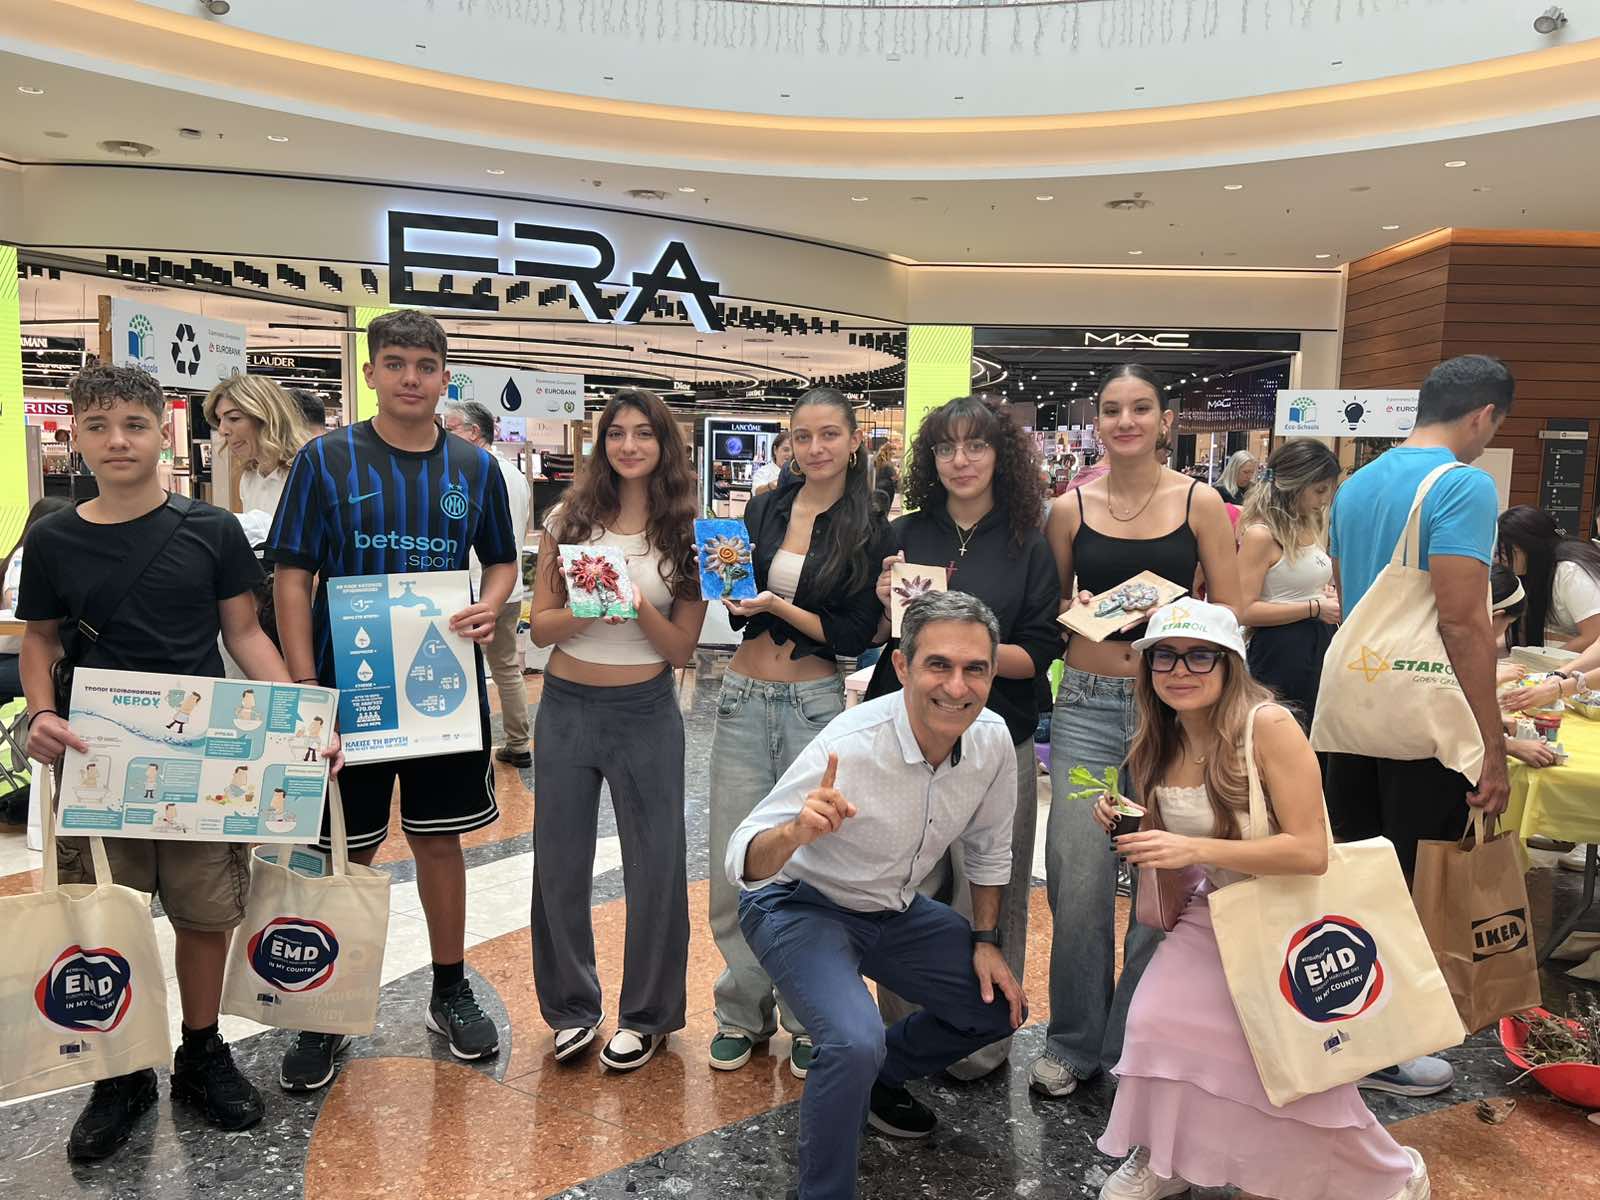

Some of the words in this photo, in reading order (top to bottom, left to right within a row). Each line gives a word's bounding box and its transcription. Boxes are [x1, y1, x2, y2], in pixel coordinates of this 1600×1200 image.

[388, 211, 726, 332] ERA
[254, 355, 295, 367] LAUDER
[545, 388, 577, 396] EUROBANK
[673, 381, 691, 391] Dior
[24, 403, 68, 414] RINS
[354, 530, 458, 553] betsson
[1161, 622, 1208, 633] STAROIL
[112, 695, 161, 707] ΝΕΡΟΥ
[1474, 921, 1520, 948] IKEA
[271, 939, 319, 961] EMD
[1304, 947, 1356, 986] EMD
[1314, 995, 1323, 1003] IN
[1323, 988, 1331, 999] MY
[1330, 974, 1364, 992] COUNTRY
[76, 999, 88, 1008] MY
